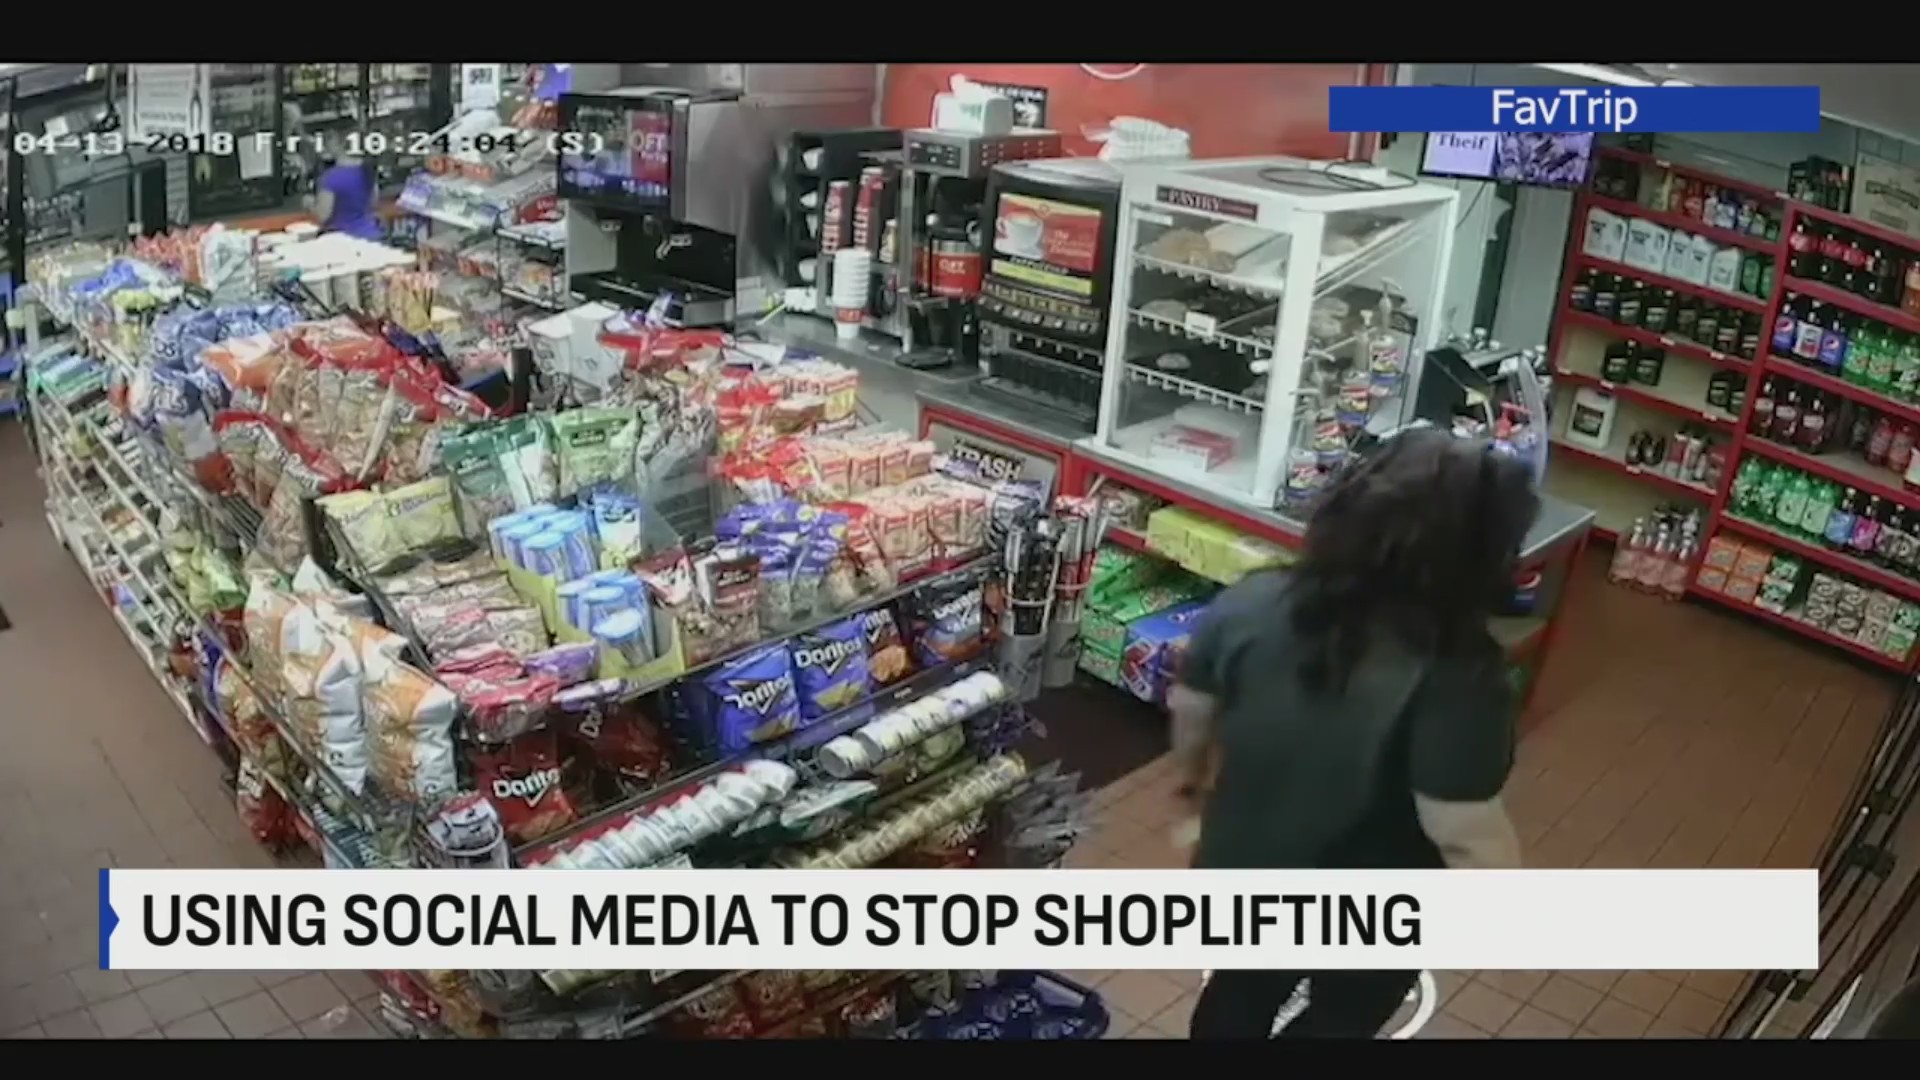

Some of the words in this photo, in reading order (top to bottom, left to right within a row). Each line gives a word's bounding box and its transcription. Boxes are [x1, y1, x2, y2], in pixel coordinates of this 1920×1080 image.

[1167, 189, 1219, 211] PASTRY
[951, 443, 1021, 481] TRASH
[795, 636, 862, 668] Doritos
[493, 767, 561, 799] Dorito
